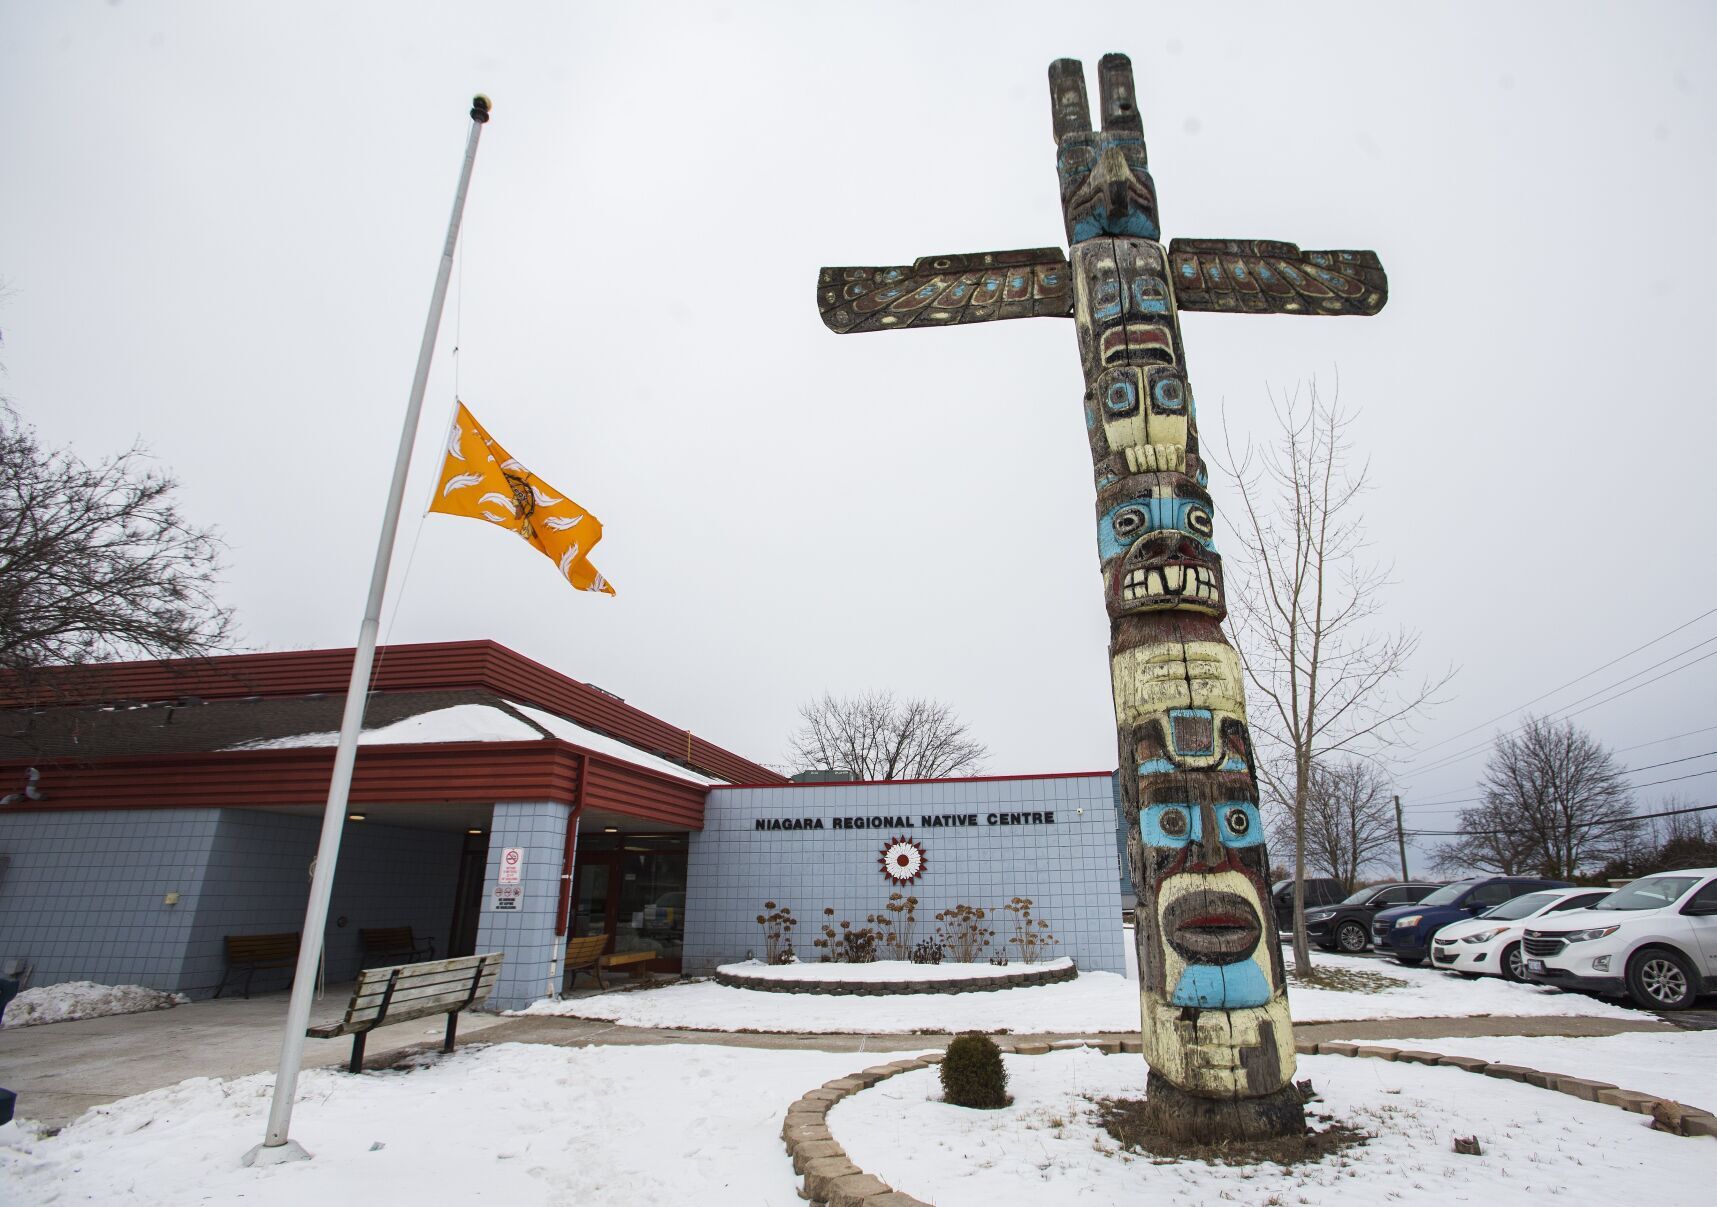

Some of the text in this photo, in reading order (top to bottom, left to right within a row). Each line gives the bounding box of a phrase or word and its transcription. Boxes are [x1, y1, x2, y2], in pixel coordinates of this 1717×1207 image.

[755, 811, 1055, 831] NIAGARA REGIONAL NATIVE CENTRE
